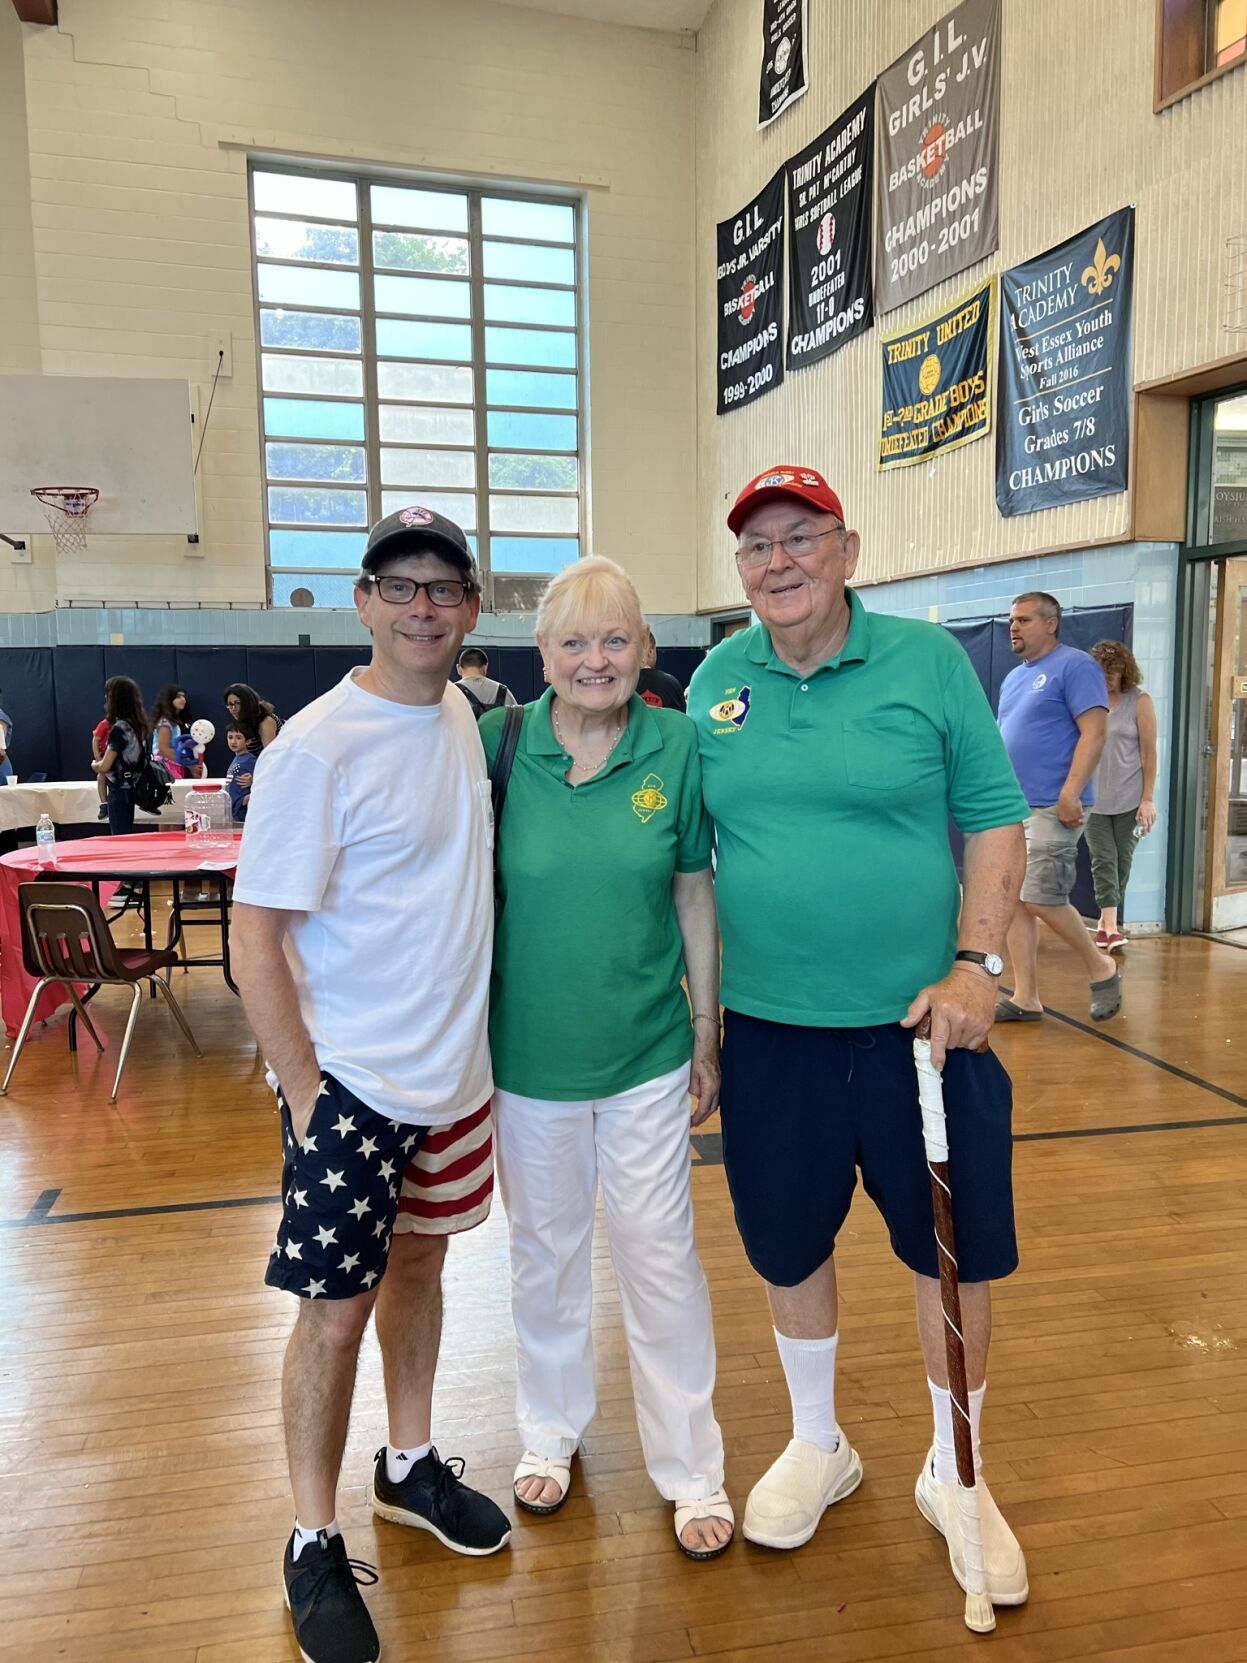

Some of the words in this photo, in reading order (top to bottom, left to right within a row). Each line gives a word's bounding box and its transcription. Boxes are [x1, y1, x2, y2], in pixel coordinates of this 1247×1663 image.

[889, 66, 950, 137] GIRLS'
[956, 36, 987, 82] J.V.
[792, 151, 822, 190] TRINITY
[824, 106, 867, 168] ACADEMY
[888, 108, 984, 192] BASKETBALL
[808, 180, 821, 202] PAT
[810, 188, 838, 223] SOFTBALL
[839, 163, 863, 199] LEAGUE
[885, 166, 987, 253] CHAMPIONS
[808, 271, 845, 307] UNDEFEATED
[810, 248, 841, 288] 2001
[1014, 262, 1073, 308] TRINITY
[791, 297, 865, 355] CHAMPIONS
[1010, 283, 1079, 331] ACADEMY
[887, 331, 930, 365] TRINITY
[936, 300, 981, 346] UNITED
[1041, 329, 1073, 354] Essex
[1075, 309, 1113, 338] Youth
[1019, 356, 1053, 381] Sports
[1055, 336, 1104, 368] Alliance
[1039, 372, 1057, 390] Fall
[1058, 364, 1079, 383] 2016
[913, 390, 950, 424] GRADE
[949, 369, 985, 408] BOYS
[1018, 402, 1049, 426] Girls
[1053, 385, 1104, 416] Soccer
[931, 397, 988, 443] CHAMPIONS
[1024, 428, 1069, 454] Grades
[1073, 416, 1095, 440] 7/8
[1009, 444, 1116, 491] CHAMPIONS
[1215, 491, 1247, 502] OYSIU
